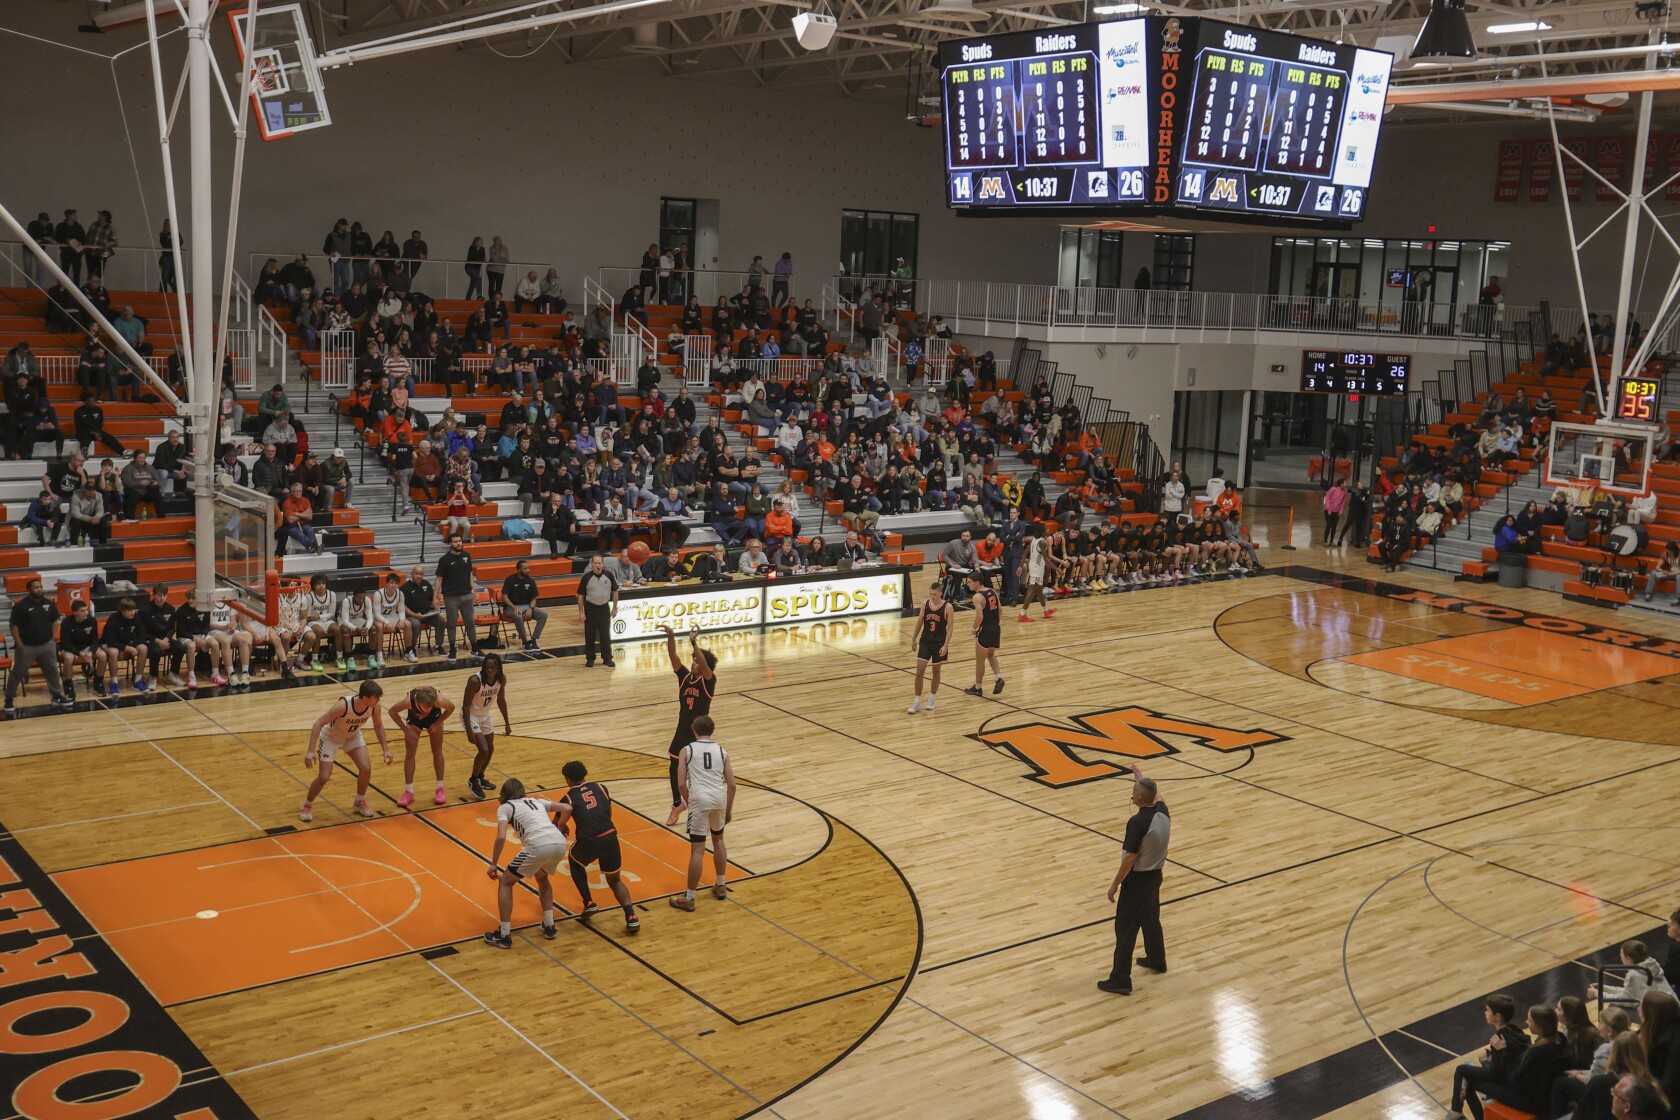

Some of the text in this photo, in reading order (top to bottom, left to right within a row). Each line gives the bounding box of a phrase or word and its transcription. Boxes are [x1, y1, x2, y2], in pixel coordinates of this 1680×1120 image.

[1036, 34, 1076, 53] Raiders
[1224, 29, 1256, 52] Spuds
[962, 43, 992, 61] Spuds
[1299, 43, 1336, 65] Raiders
[1029, 58, 1087, 76] PLYR FLS PTS
[1207, 55, 1264, 76] PLYR FLS PTS
[953, 67, 1004, 84] PLYR FLS PTS
[1287, 69, 1340, 88] PLYR FLS PTS
[959, 87, 1001, 103] 3 0 0
[1036, 79, 1083, 96] 0 0 3
[1118, 85, 1141, 96] RE/MAX
[1210, 77, 1256, 98] 3 0 0
[959, 101, 1002, 117] 4 1 3
[1038, 95, 1084, 111] 1 0 5
[1207, 94, 1254, 113] 4 1 3
[1290, 90, 1333, 110] 0 0 3
[960, 116, 1003, 132] 5 0 2
[1036, 111, 1084, 126] 11 1 4
[1204, 109, 1251, 129] 5 0 2
[1288, 106, 1330, 125] 1 0 5
[1036, 125, 1085, 142] 12 0 4
[1154, 53, 1179, 202] MOORHEAD
[1201, 125, 1248, 145] 12 0 0
[1284, 121, 1327, 139] 11 1 4
[959, 131, 1004, 145] 12 0 0
[1281, 136, 1324, 153] 12 0 4
[960, 145, 1004, 160] 14 1 4
[1037, 141, 1086, 156] 13 1 0
[1198, 142, 1246, 160] 14 1 4
[1278, 151, 1322, 169] 13 1 0
[954, 177, 970, 198] 14
[980, 177, 1005, 198] M
[1025, 177, 1058, 198] 10:37
[1121, 171, 1142, 195] 26
[1184, 173, 1202, 198] 14
[1210, 177, 1238, 202] M
[1259, 185, 1291, 206] 10:37
[1341, 188, 1361, 212] 26
[1315, 363, 1324, 372] 14
[1345, 354, 1373, 365] 10:37
[1391, 366, 1405, 377] 26
[1310, 379, 1314, 387] 3
[1347, 381, 1356, 389] 13
[1626, 382, 1656, 395] 10:37
[1624, 395, 1653, 418] 35
[636, 596, 760, 620] MOORHEAD
[770, 588, 868, 618] SPUDS
[689, 612, 753, 628] SCHOOL
[930, 622, 936, 631] 3
[963, 704, 1294, 789] M
[703, 752, 712, 769] 0
[524, 800, 539, 810] 11
[582, 790, 598, 810] 5
